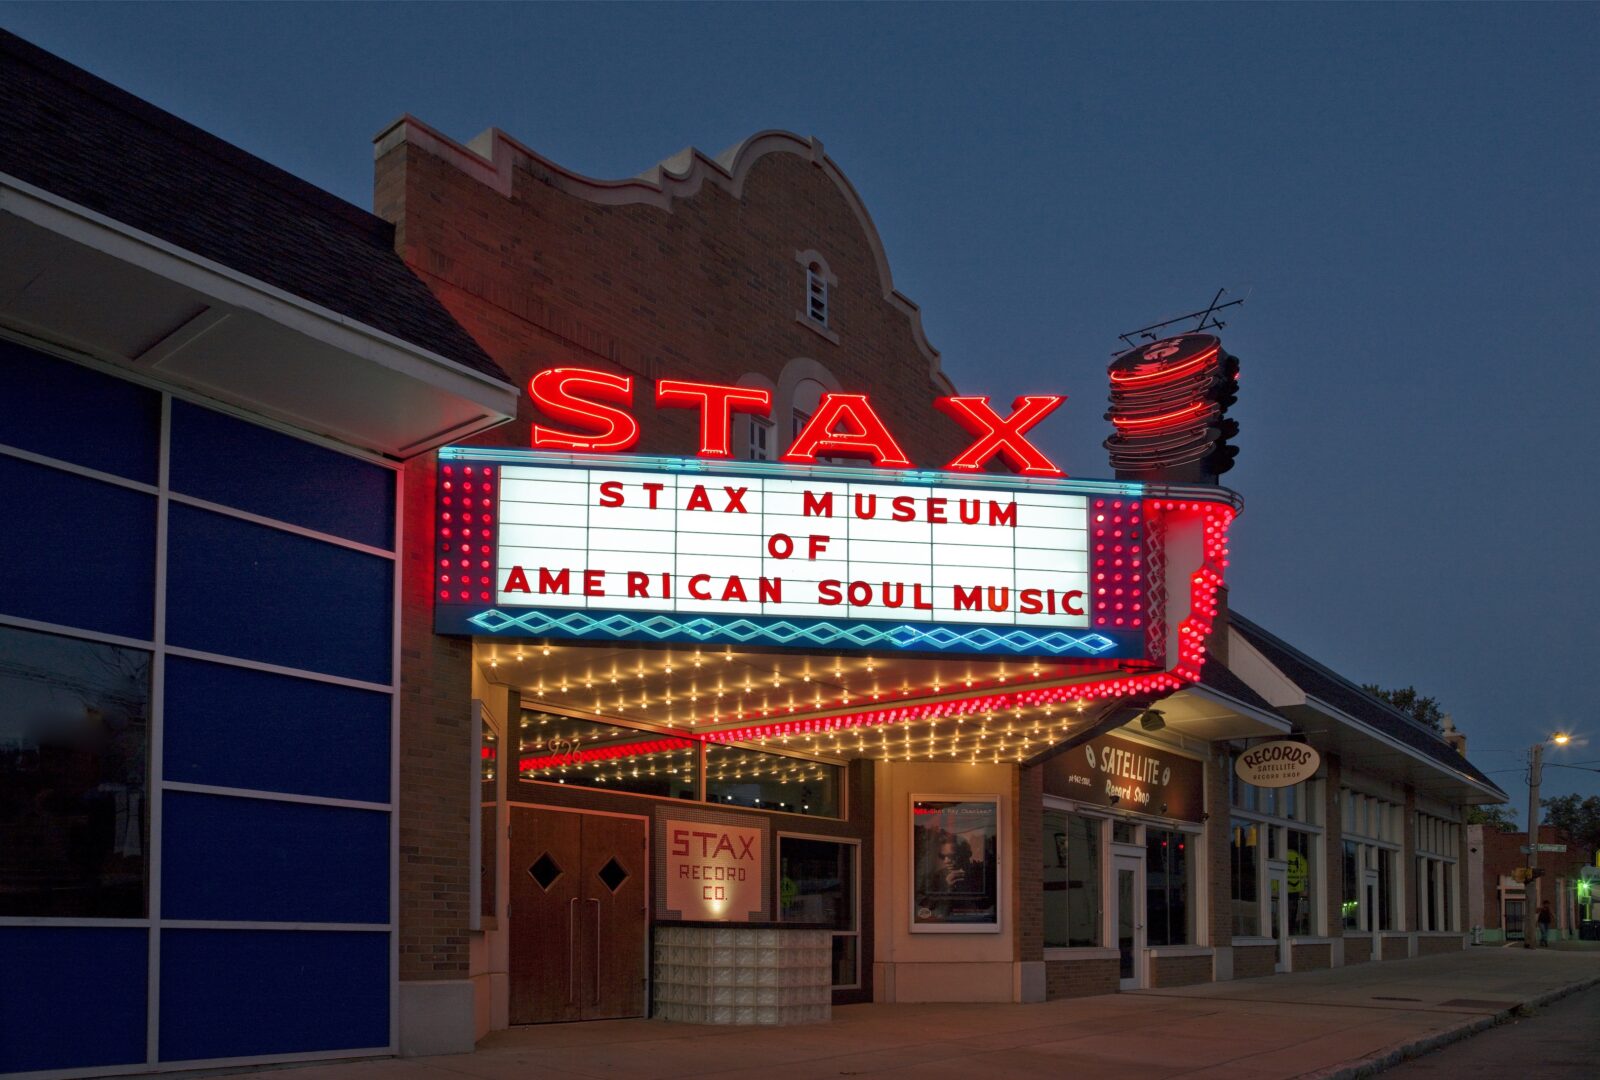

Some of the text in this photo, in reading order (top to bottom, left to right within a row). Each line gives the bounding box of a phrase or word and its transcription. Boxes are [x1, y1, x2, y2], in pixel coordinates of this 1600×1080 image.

[528, 368, 1068, 477] STAX
[598, 481, 1018, 528] STAX MUSEUM
[767, 533, 830, 562] OF
[503, 565, 1085, 616] AMERICAN SOUL MUSIC
[547, 738, 583, 764] 926
[1100, 746, 1160, 785] SATELLITE
[1243, 746, 1312, 769] RECORDS
[1256, 763, 1296, 773] SATELLITE
[1105, 779, 1132, 800] Record
[1133, 786, 1150, 807] Shop
[672, 829, 755, 861] STAX
[680, 864, 746, 882] RECORD
